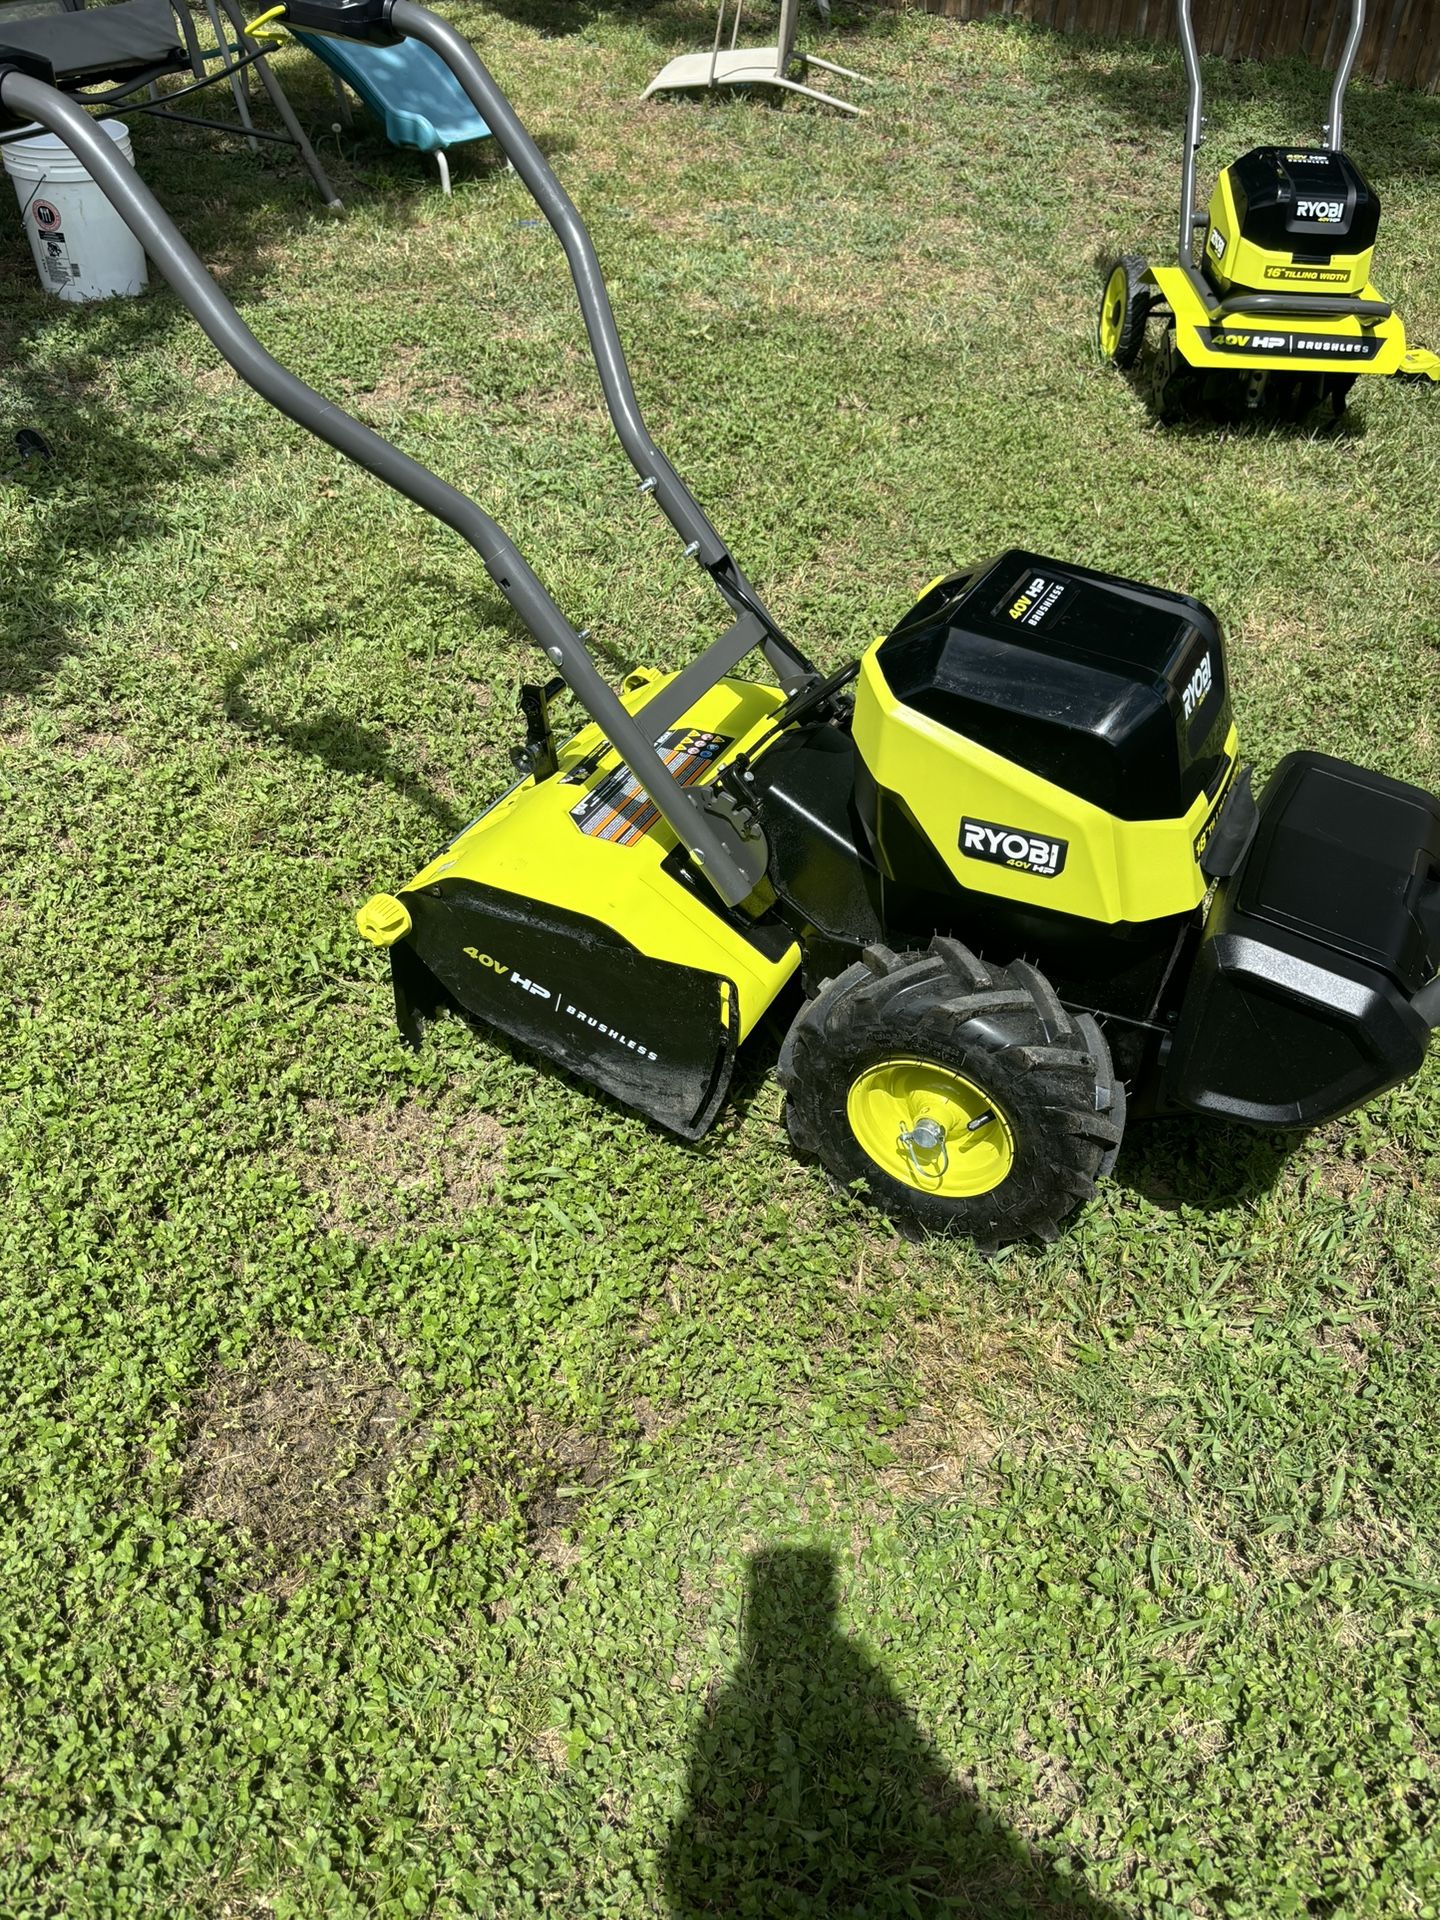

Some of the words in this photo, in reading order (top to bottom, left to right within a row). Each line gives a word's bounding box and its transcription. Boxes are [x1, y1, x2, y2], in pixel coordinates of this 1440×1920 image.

[1296, 201, 1344, 218] RYOBI
[1285, 270, 1318, 279] TILLING
[1319, 272, 1348, 281] WIDTH
[1211, 335, 1250, 347] 40V
[1252, 335, 1286, 348] HP
[1297, 340, 1369, 353] BRUSHLESS
[1008, 595, 1032, 619] 40V
[1025, 578, 1045, 598] HP
[1028, 585, 1065, 626] BRUSHLESS
[1182, 651, 1212, 721] RYOBI
[964, 823, 1060, 868] RYOBI
[1006, 859, 1032, 870] 40V
[1032, 864, 1055, 874] HP
[462, 946, 509, 974] 40V
[510, 971, 551, 999] HP
[566, 1004, 658, 1061] BRUSHLESS
